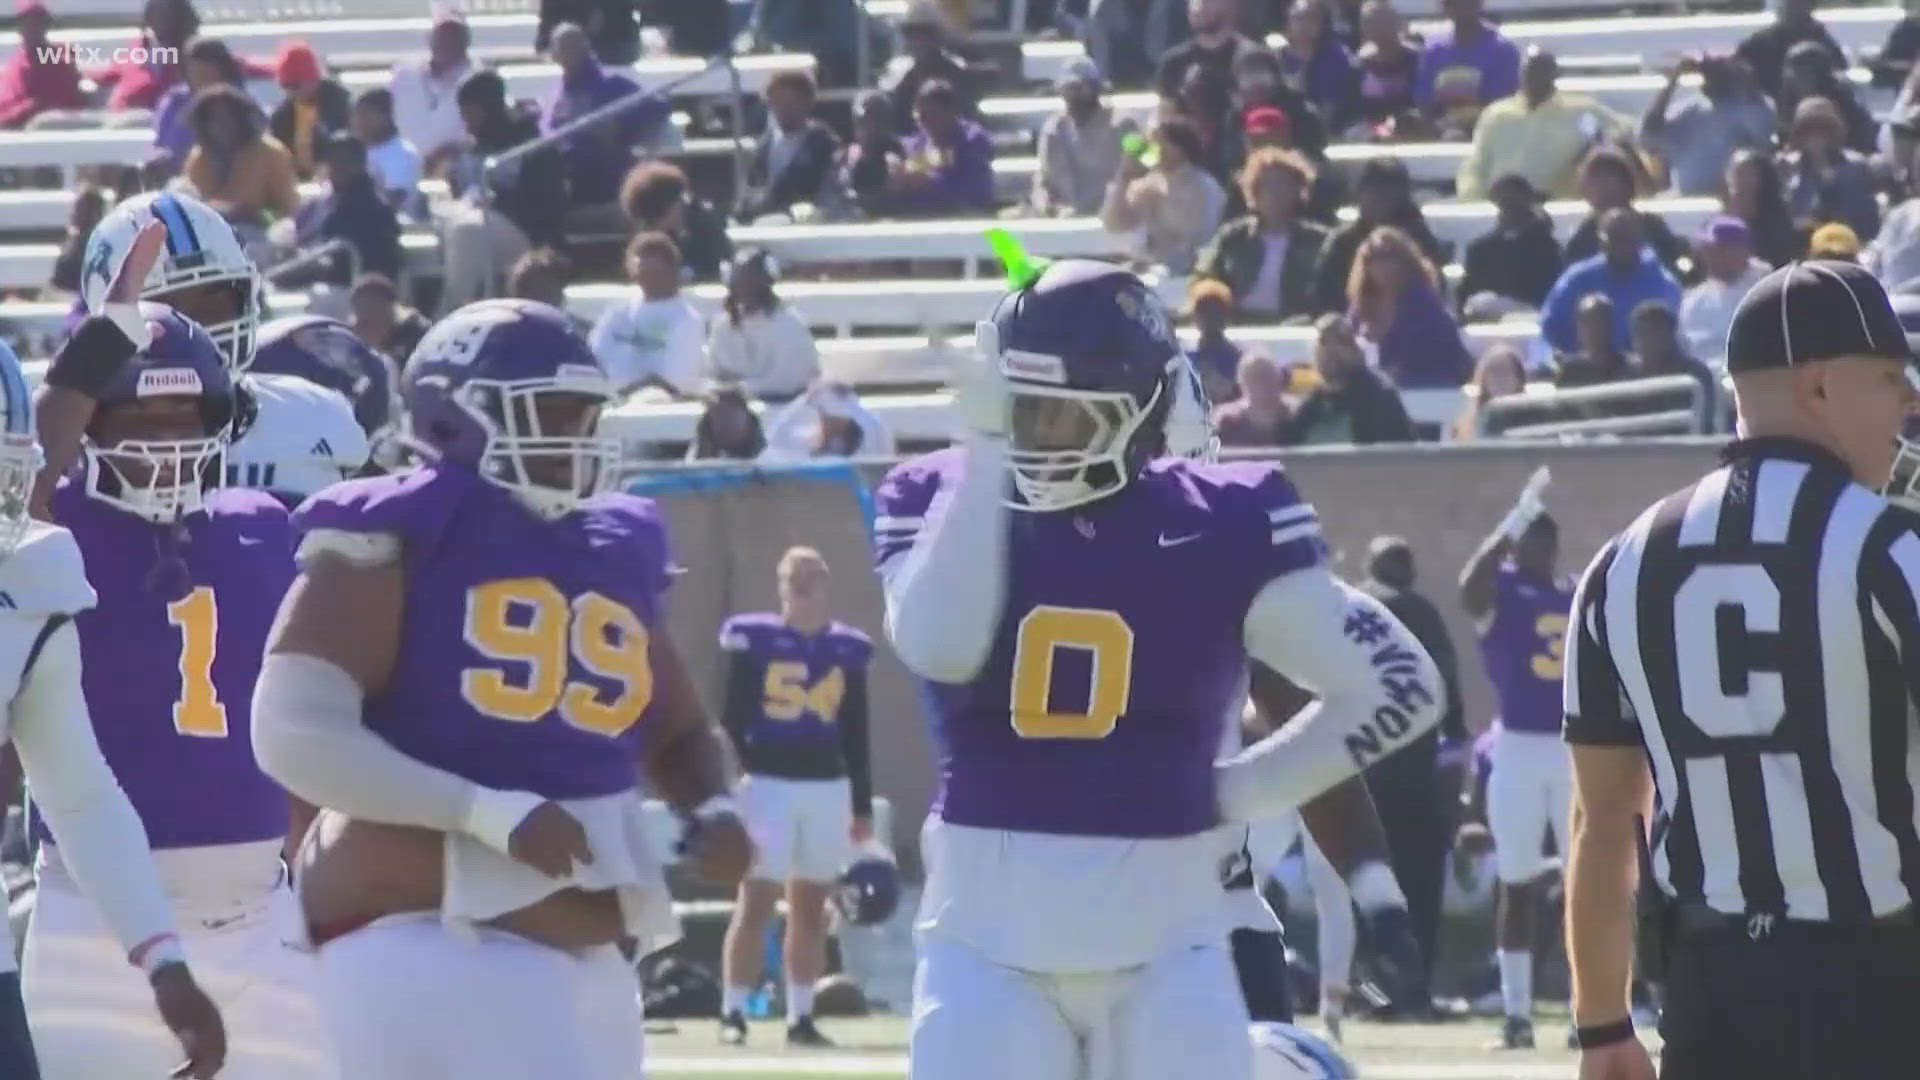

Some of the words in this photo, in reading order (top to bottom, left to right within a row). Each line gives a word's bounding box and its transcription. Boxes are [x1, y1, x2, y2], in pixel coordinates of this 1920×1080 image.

[144, 372, 197, 387] Riddell
[167, 585, 229, 738] 1
[462, 578, 653, 738] 99
[764, 661, 845, 723] 54
[1010, 604, 1134, 738] 0
[1674, 563, 1785, 737] C
